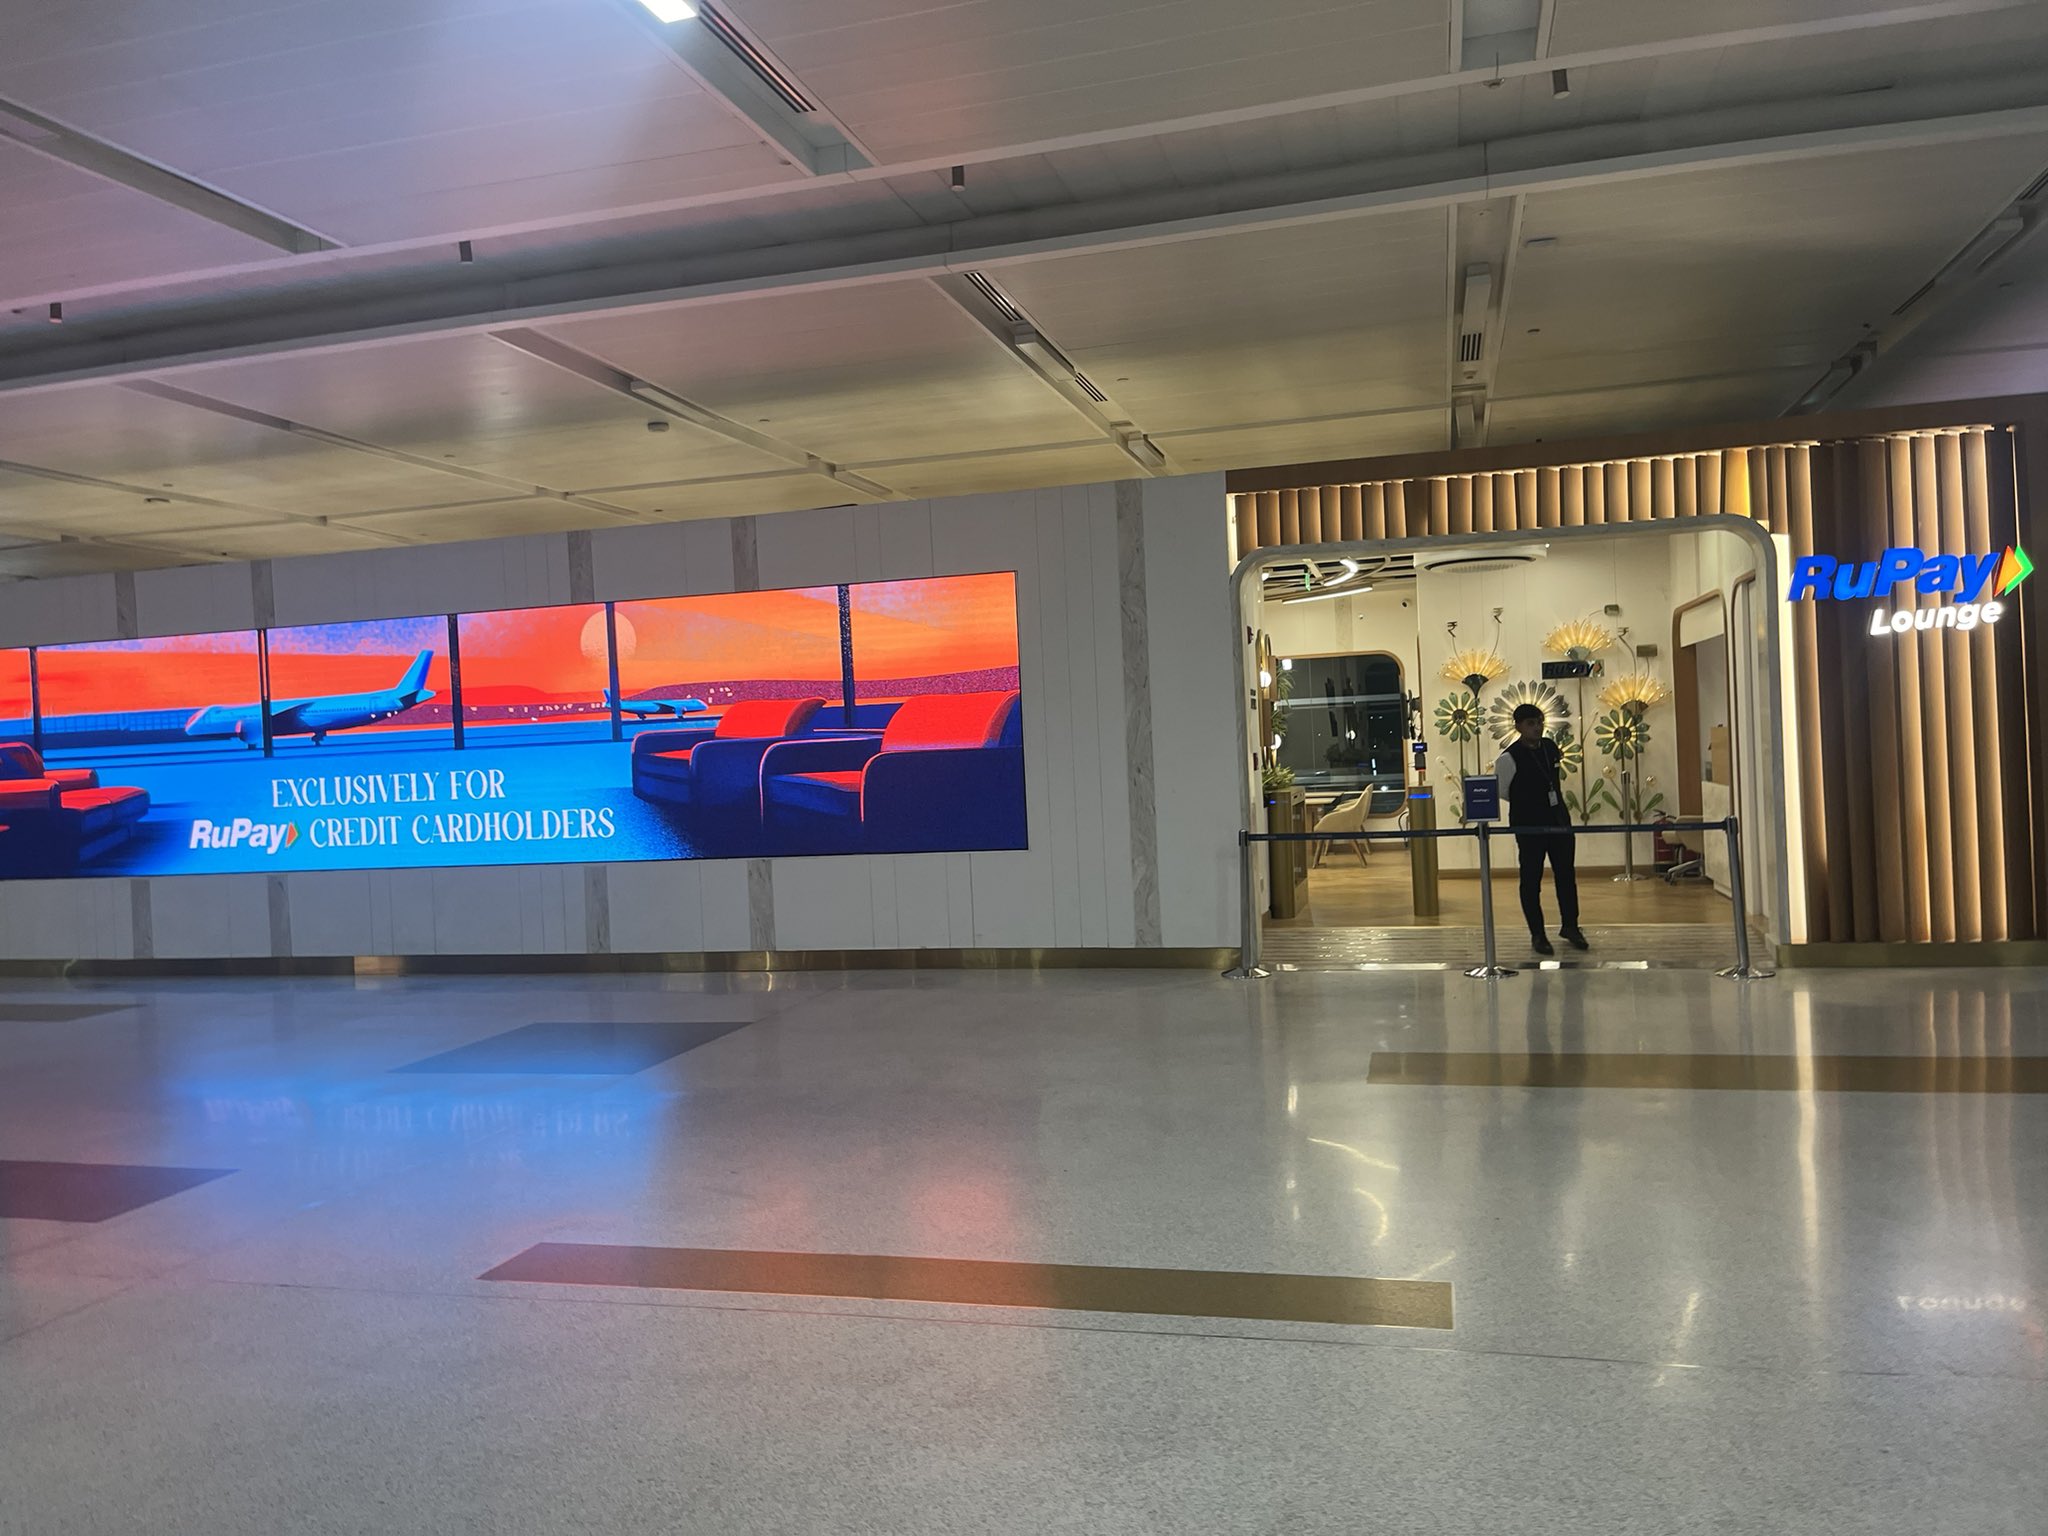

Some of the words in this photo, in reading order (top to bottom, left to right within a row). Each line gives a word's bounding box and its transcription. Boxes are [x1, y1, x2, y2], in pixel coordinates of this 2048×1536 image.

[1788, 548, 1999, 603] RuPay
[1870, 602, 2003, 636] Lounge
[272, 771, 441, 808] EXCLUSIVELY
[450, 769, 506, 799] FOR
[189, 818, 288, 854] RuPay
[310, 816, 402, 848] CREDIT
[412, 807, 615, 845] CARDHOLDERS
